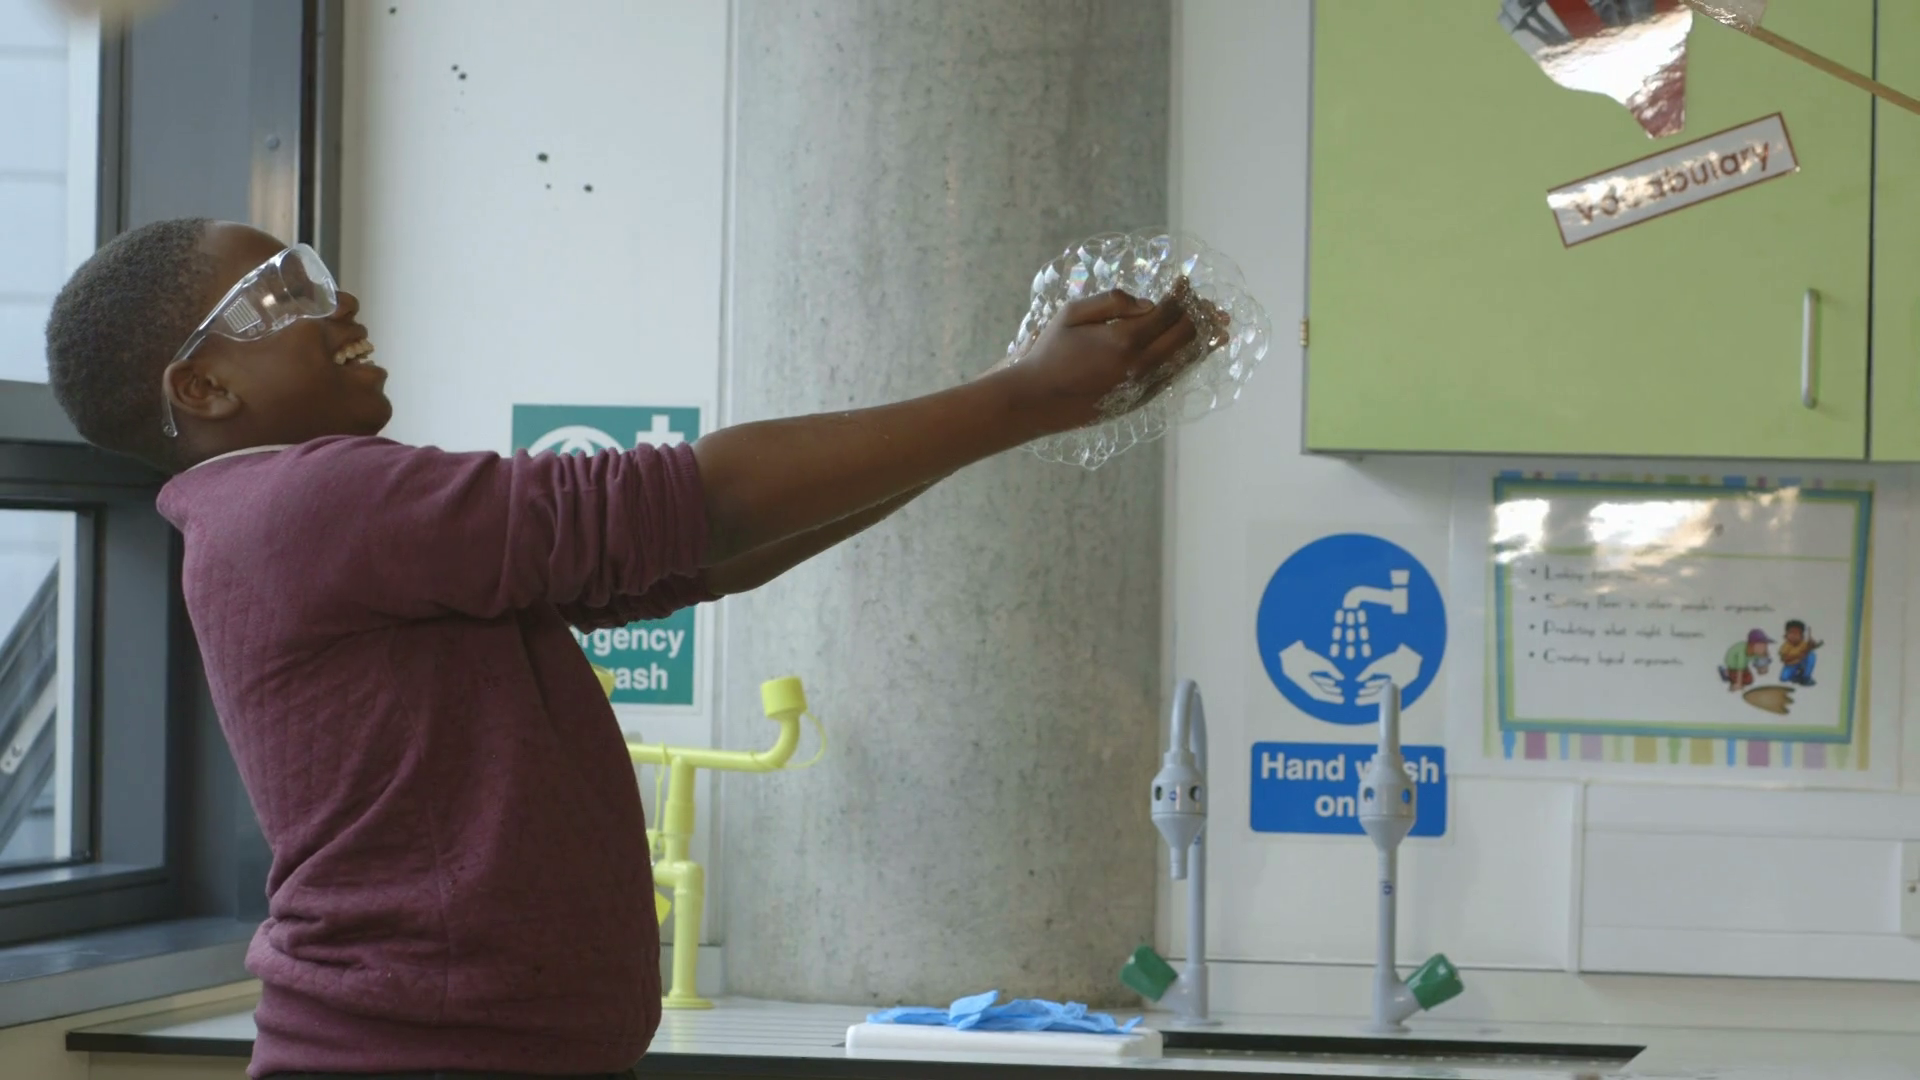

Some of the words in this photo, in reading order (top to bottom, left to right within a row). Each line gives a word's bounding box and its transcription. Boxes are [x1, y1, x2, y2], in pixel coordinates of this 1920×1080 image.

[571, 626, 686, 659] rgency
[609, 662, 668, 690] ash
[1261, 752, 1345, 781] Hand
[1355, 755, 1440, 784] wsh
[1314, 794, 1356, 818] on
